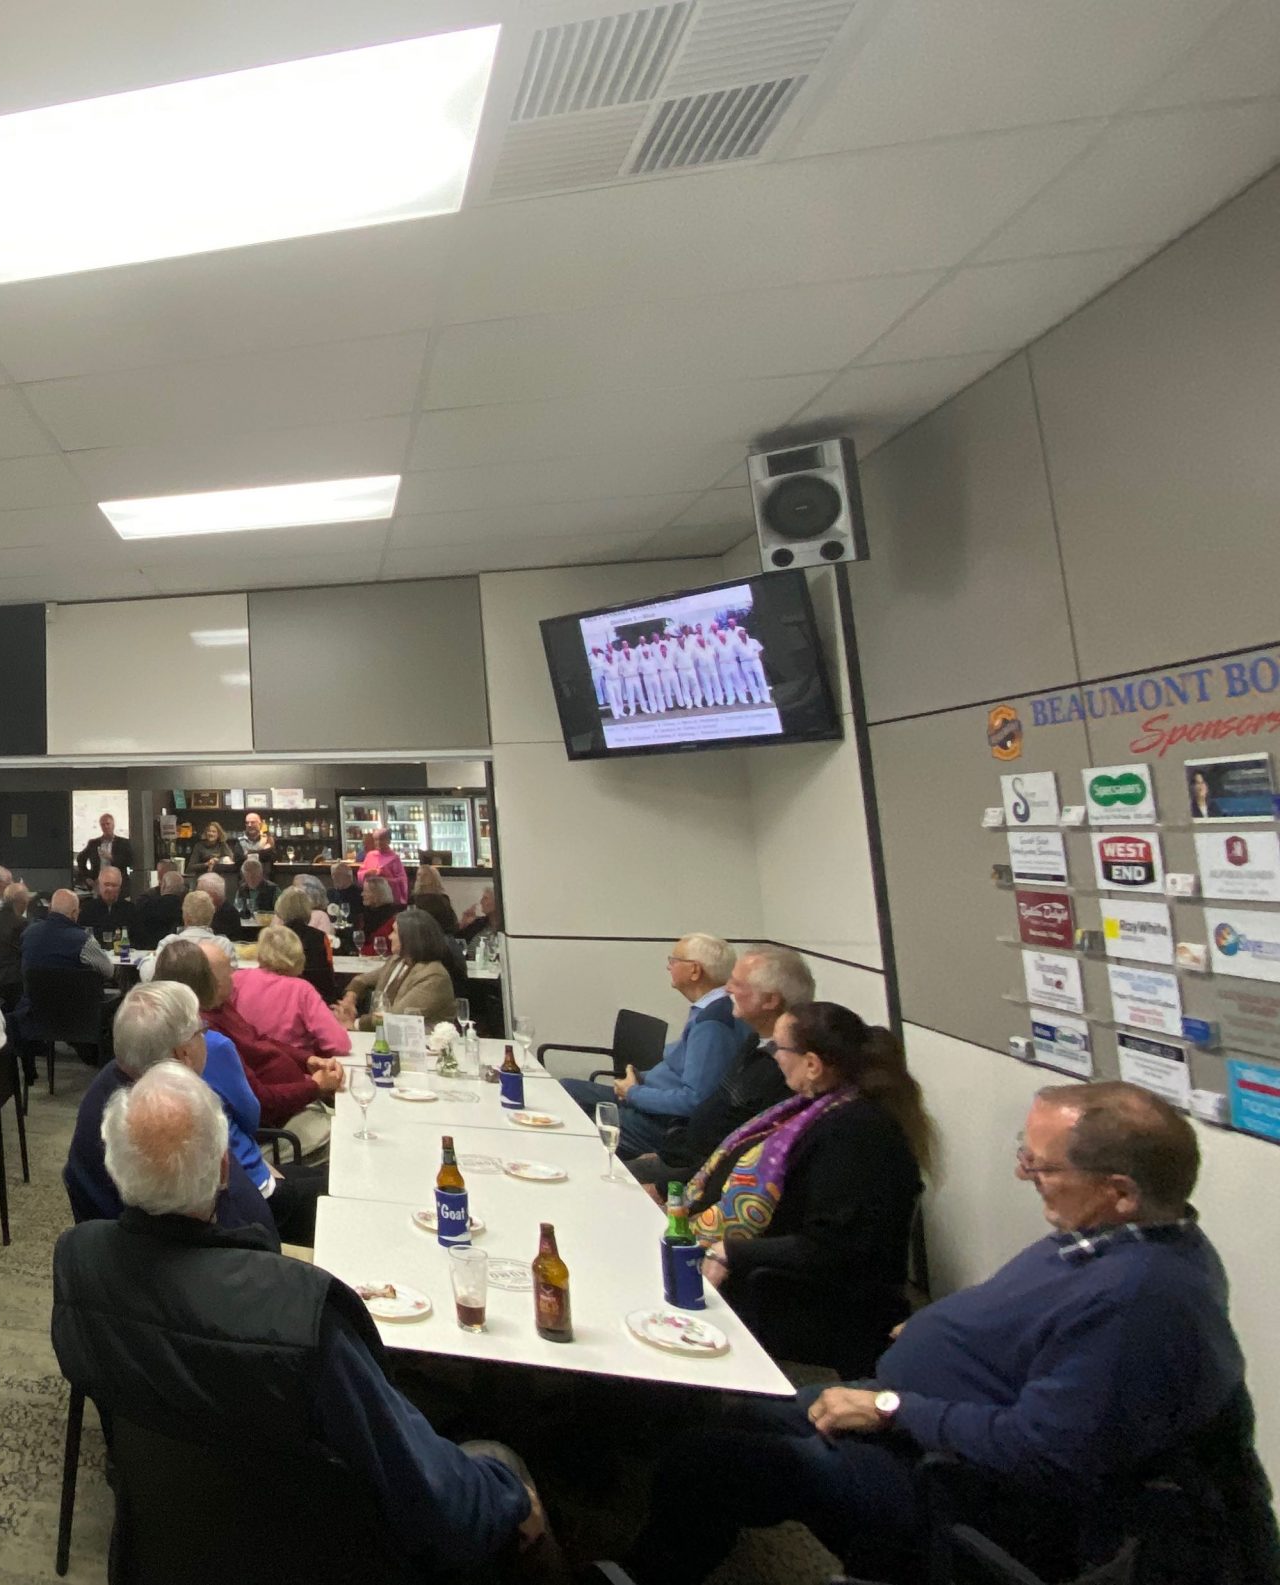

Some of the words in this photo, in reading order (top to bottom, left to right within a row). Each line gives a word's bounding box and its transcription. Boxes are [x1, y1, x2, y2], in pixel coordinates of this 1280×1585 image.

[1030, 669, 1213, 727] BEAUMONT
[1222, 655, 1280, 698] BO
[1102, 842, 1146, 858] WEST
[1111, 865, 1146, 881] END
